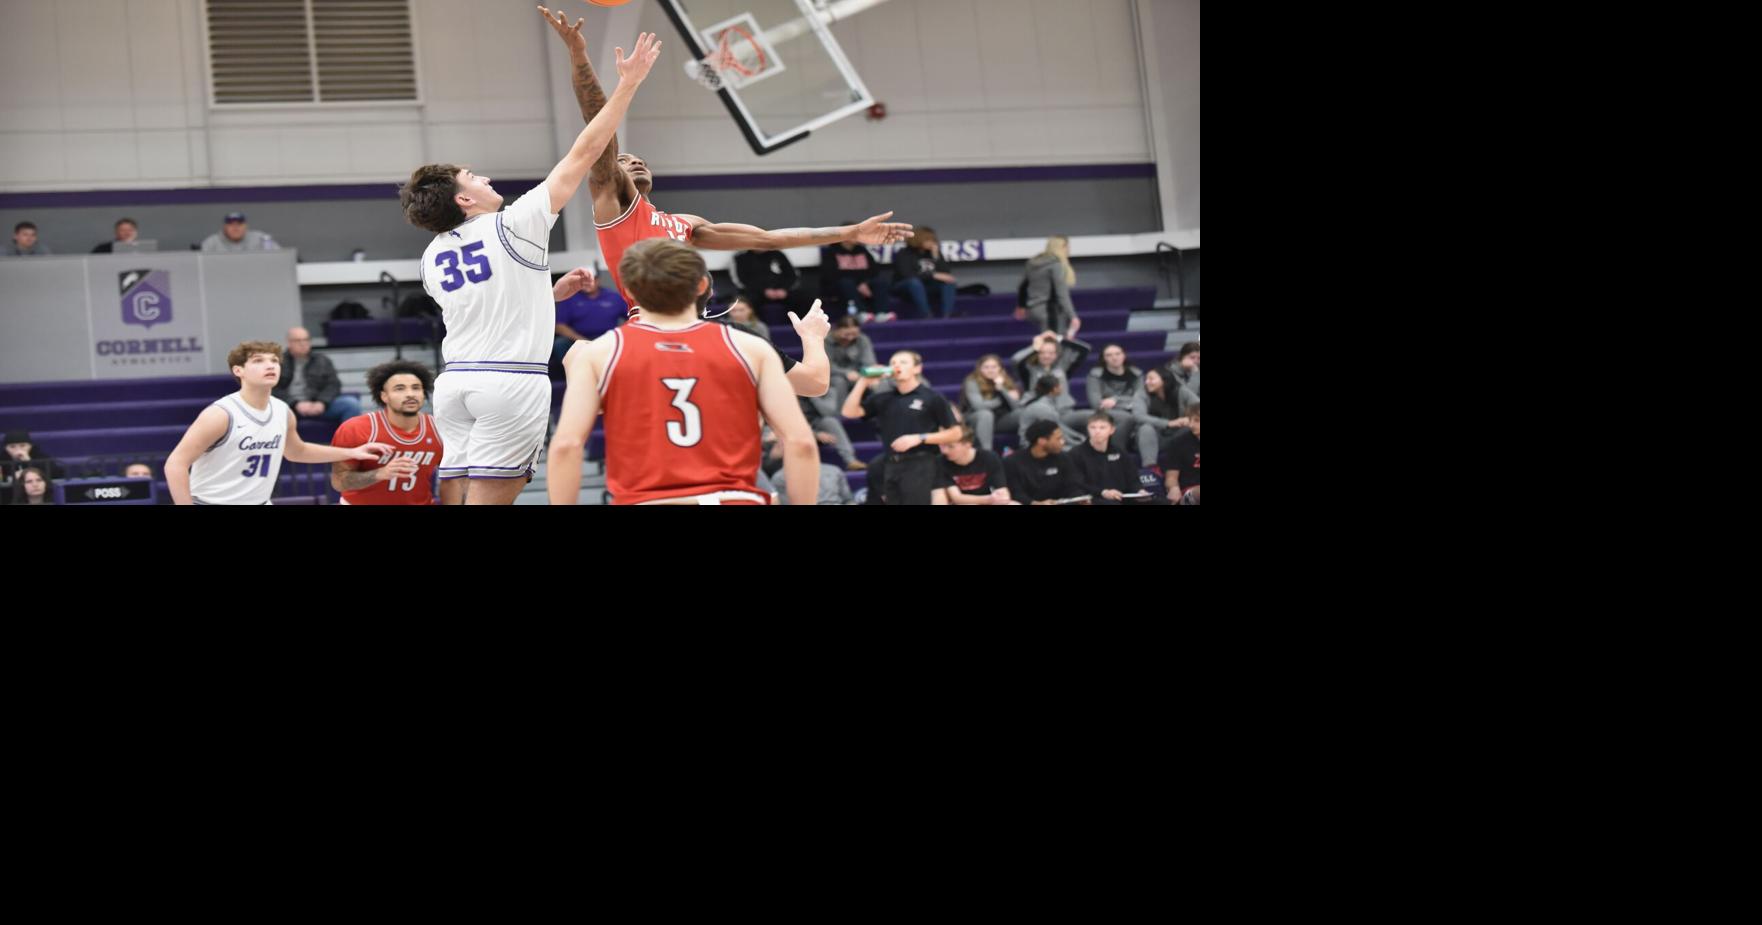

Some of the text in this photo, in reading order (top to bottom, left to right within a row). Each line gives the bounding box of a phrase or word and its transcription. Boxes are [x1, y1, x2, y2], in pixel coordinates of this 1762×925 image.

[435, 240, 493, 293] 35
[133, 291, 160, 320] C
[97, 337, 203, 356] CORNELL
[660, 377, 702, 448] 3
[239, 434, 281, 450] Cornell
[242, 454, 271, 477] 31
[94, 487, 121, 498] POSS
